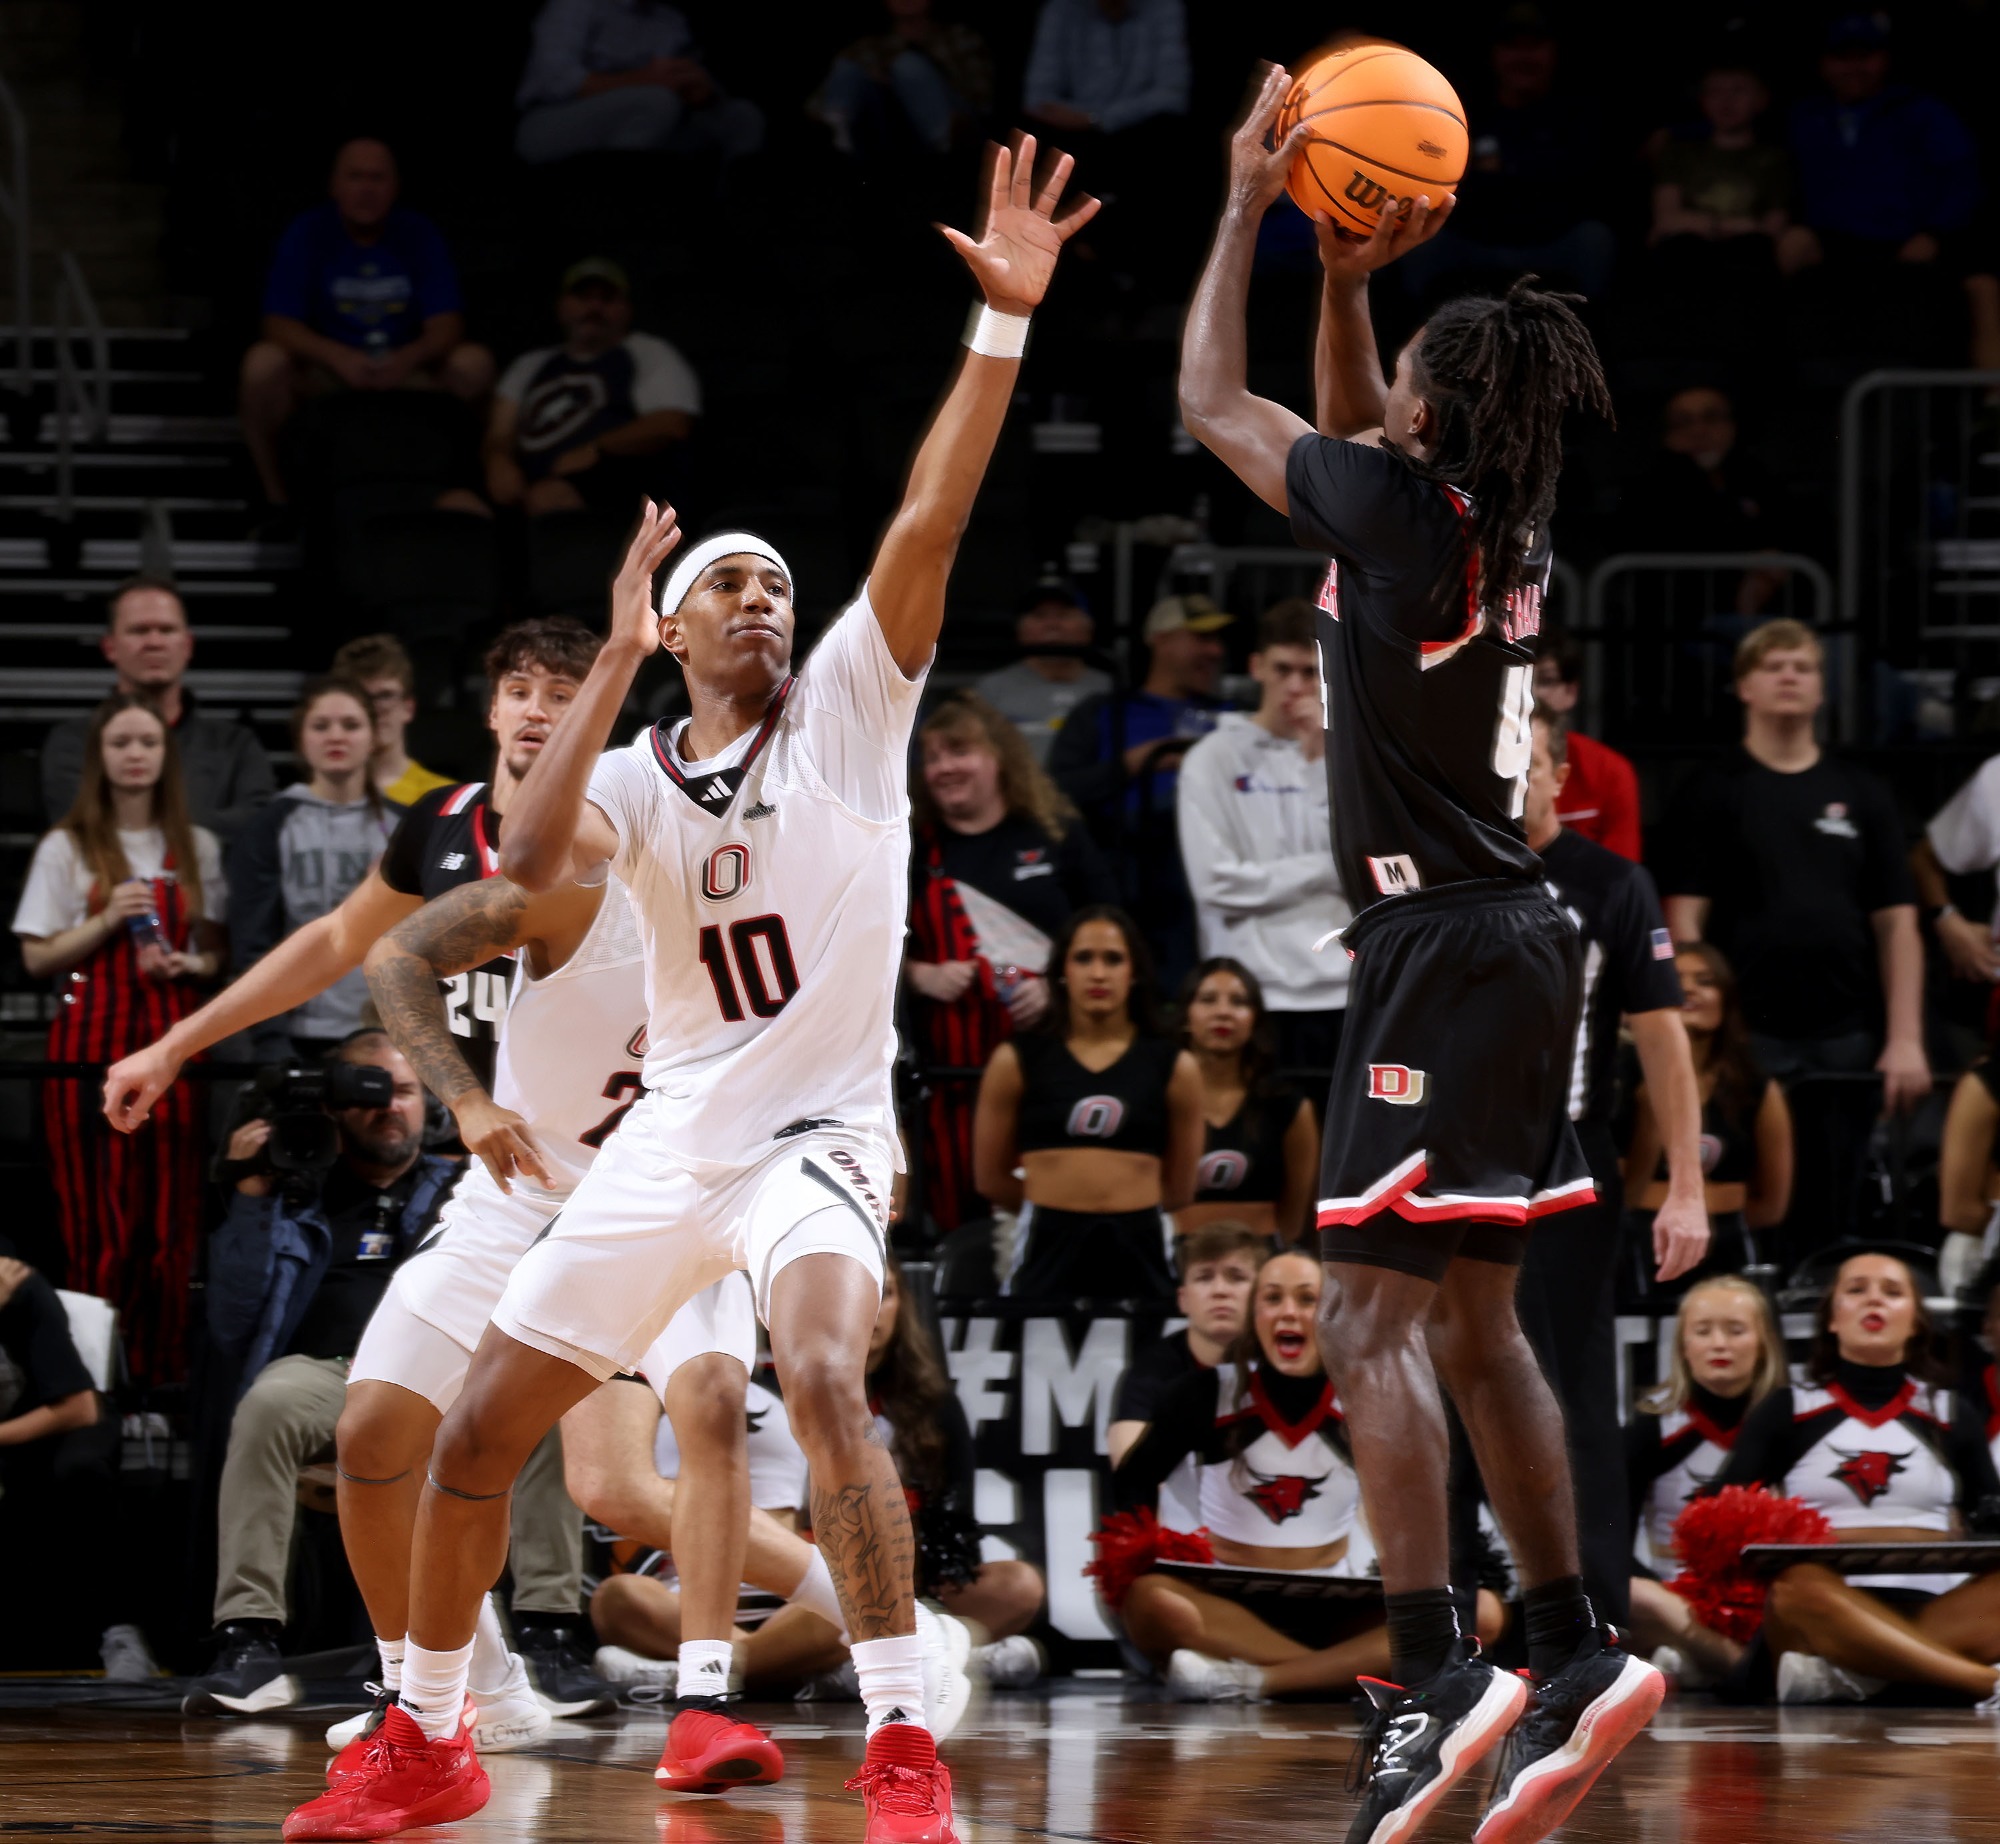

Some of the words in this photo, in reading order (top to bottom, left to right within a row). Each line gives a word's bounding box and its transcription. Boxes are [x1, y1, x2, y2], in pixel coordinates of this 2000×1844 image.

[1384, 862, 1407, 885] M
[699, 913, 801, 1022] 10
[441, 970, 508, 1043] 24
[1368, 1064, 1425, 1105] DU
